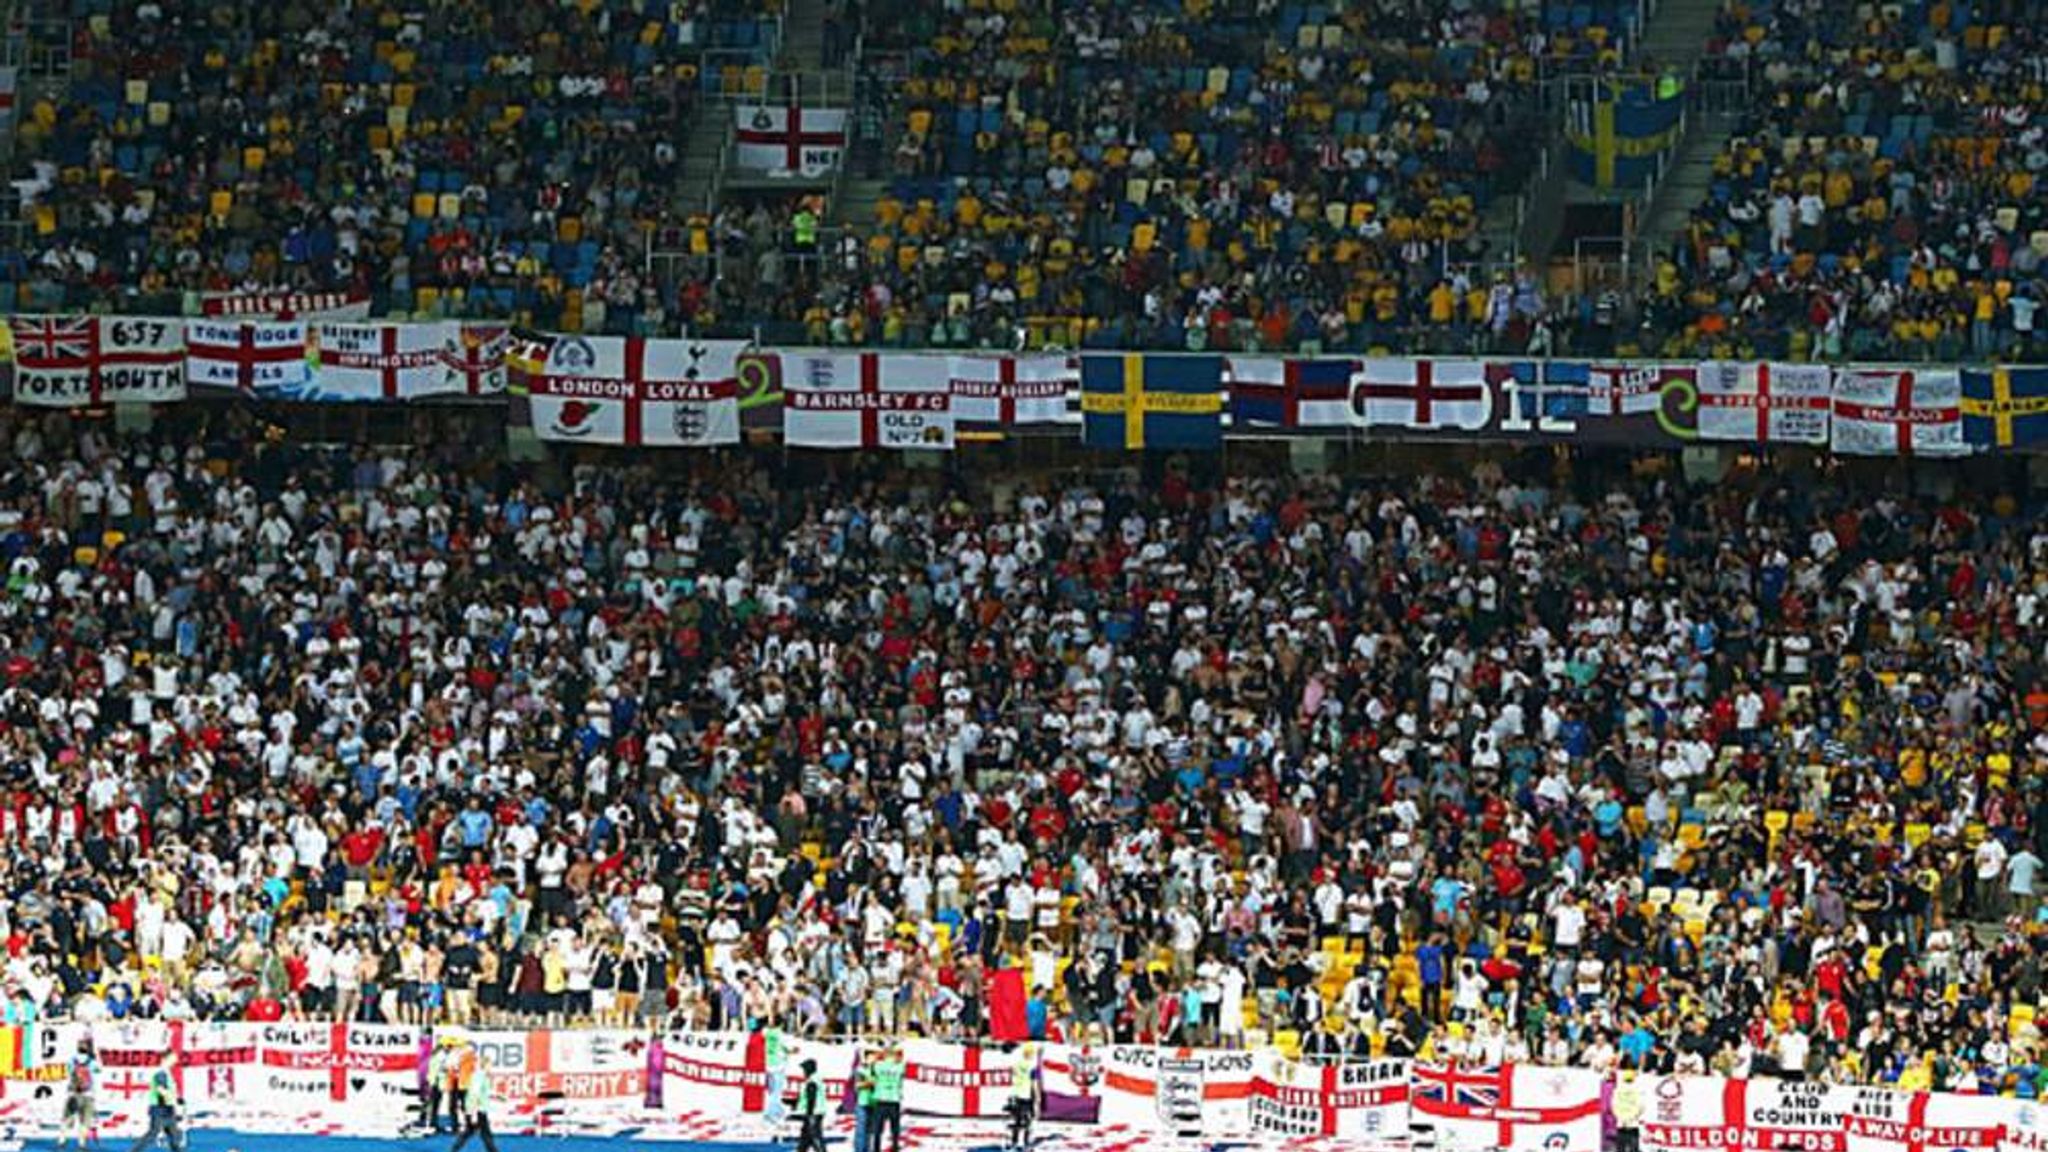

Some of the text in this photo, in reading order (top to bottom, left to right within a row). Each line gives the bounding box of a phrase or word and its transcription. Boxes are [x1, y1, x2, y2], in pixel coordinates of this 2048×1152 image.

[17, 368, 181, 396] PORTSMOUTH
[550, 377, 714, 399] LONDON LOYAL
[795, 393, 944, 410] BARNSLEY FC
[884, 413, 924, 427] OLD
[349, 1029, 411, 1047] EVANS
[99, 1049, 191, 1067] BRADFD
[291, 1052, 385, 1071] ENGLAND
[561, 1071, 624, 1098] ARMY
[1779, 1094, 1821, 1111] AND
[1753, 1108, 1843, 1126] COUNTRY
[1938, 1131, 1982, 1145] LIFE
